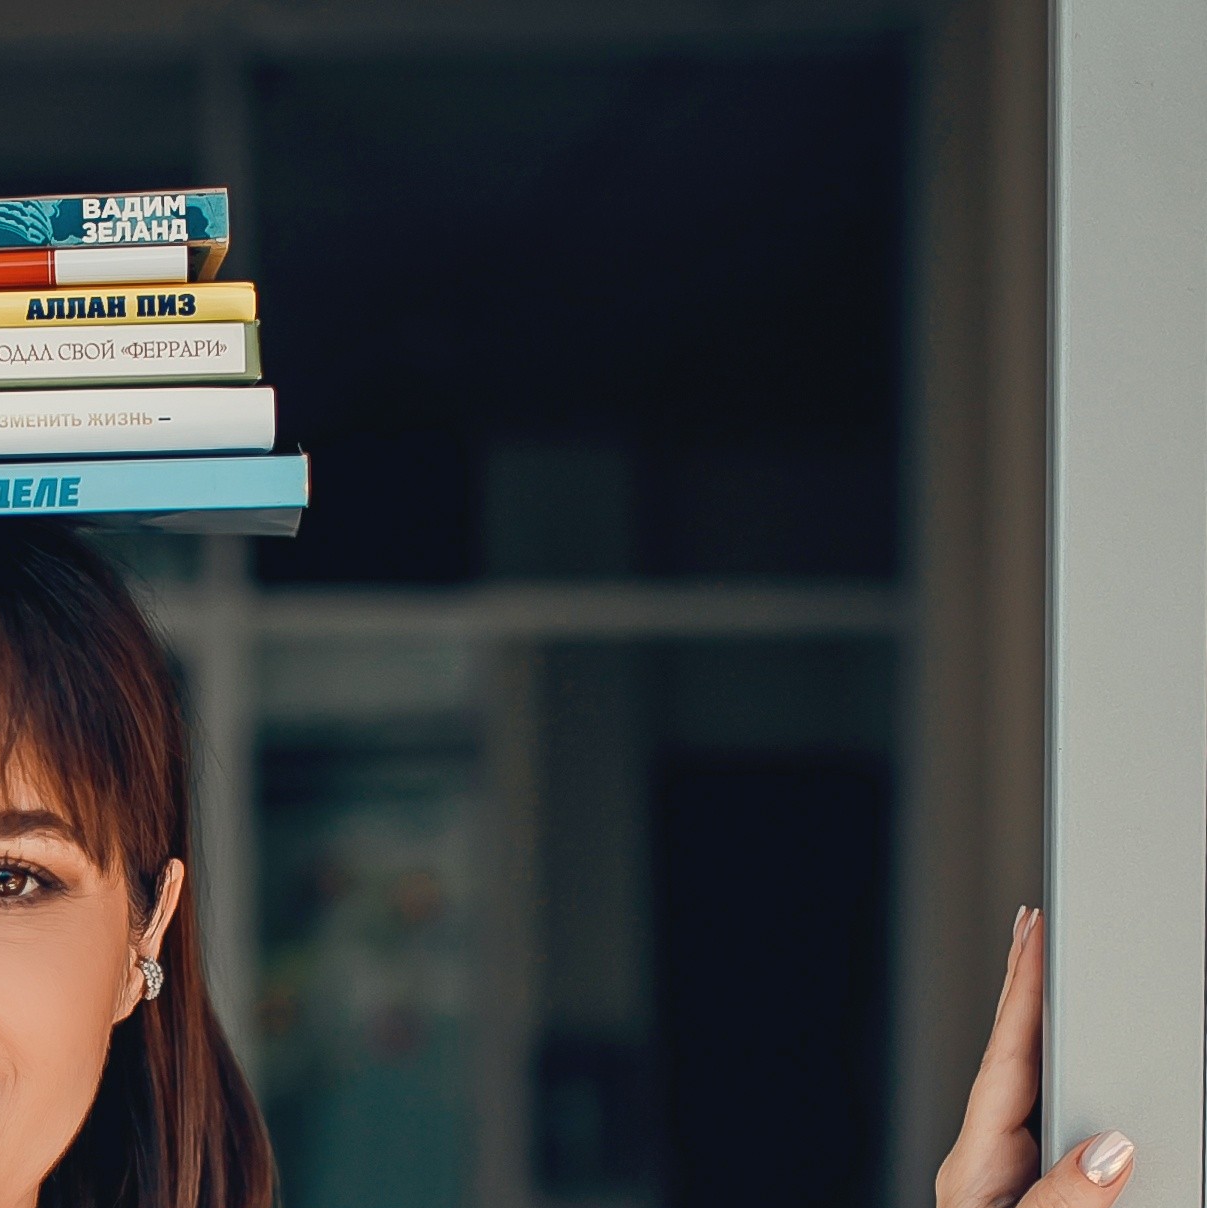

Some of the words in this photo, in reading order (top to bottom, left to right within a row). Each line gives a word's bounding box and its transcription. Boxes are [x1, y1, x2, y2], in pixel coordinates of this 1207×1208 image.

[82, 194, 186, 219] ВАДИМ
[82, 217, 188, 244] ЗЕЛАНД
[25, 296, 127, 321] АЛЛАН
[136, 293, 197, 318] ПИЗ
[58, 338, 115, 361] СВОЙ
[120, 338, 228, 360] «ФЕРРАРИ»
[87, 411, 153, 428] ЖИЗНЬ
